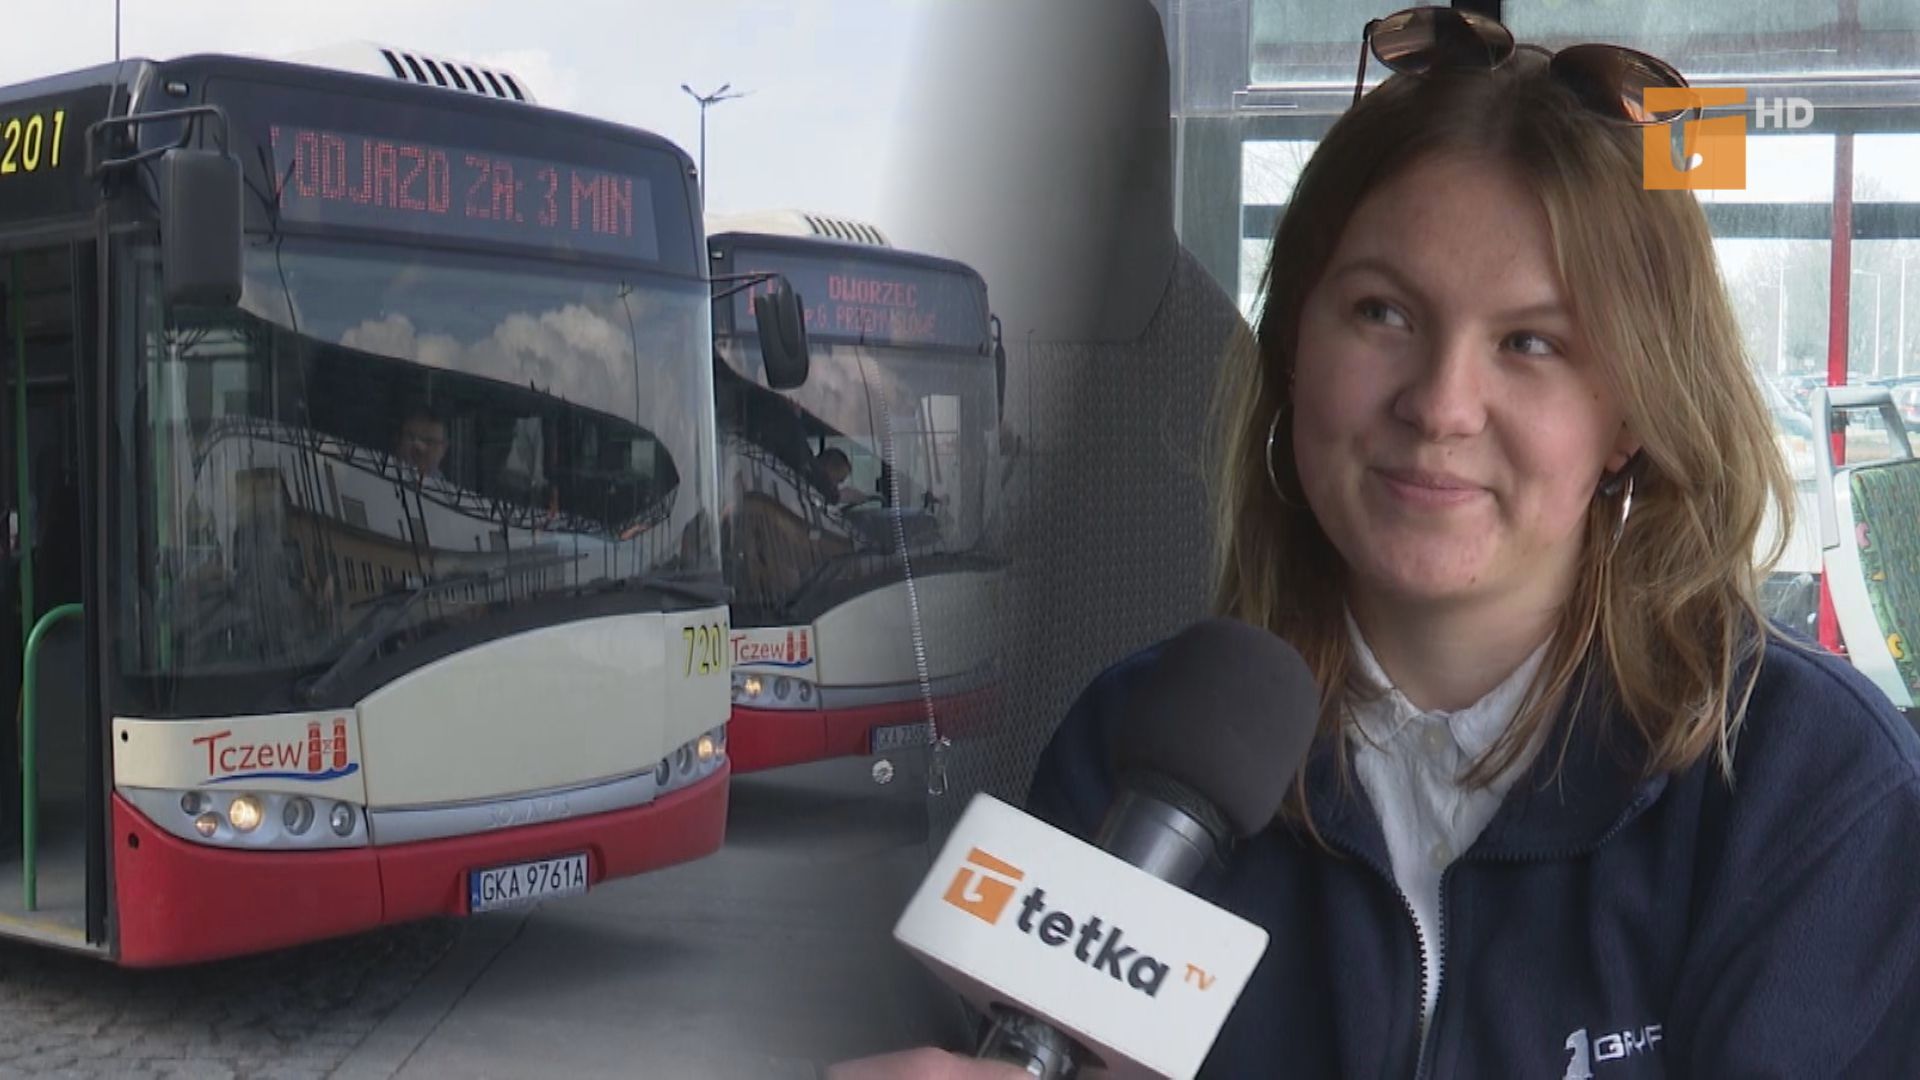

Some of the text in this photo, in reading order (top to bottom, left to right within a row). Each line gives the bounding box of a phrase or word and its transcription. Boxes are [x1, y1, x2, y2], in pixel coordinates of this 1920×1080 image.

[0, 109, 65, 174] 201
[295, 132, 633, 237] ODJAZD ZA: 3 MIN
[829, 275, 918, 309] DWORZEC
[730, 634, 785, 662] Tczew
[193, 729, 303, 776] Tczew
[483, 859, 583, 900] GKA 9761A
[1016, 887, 1216, 998] tetka TV
[1594, 1024, 1662, 1062] GRYF
